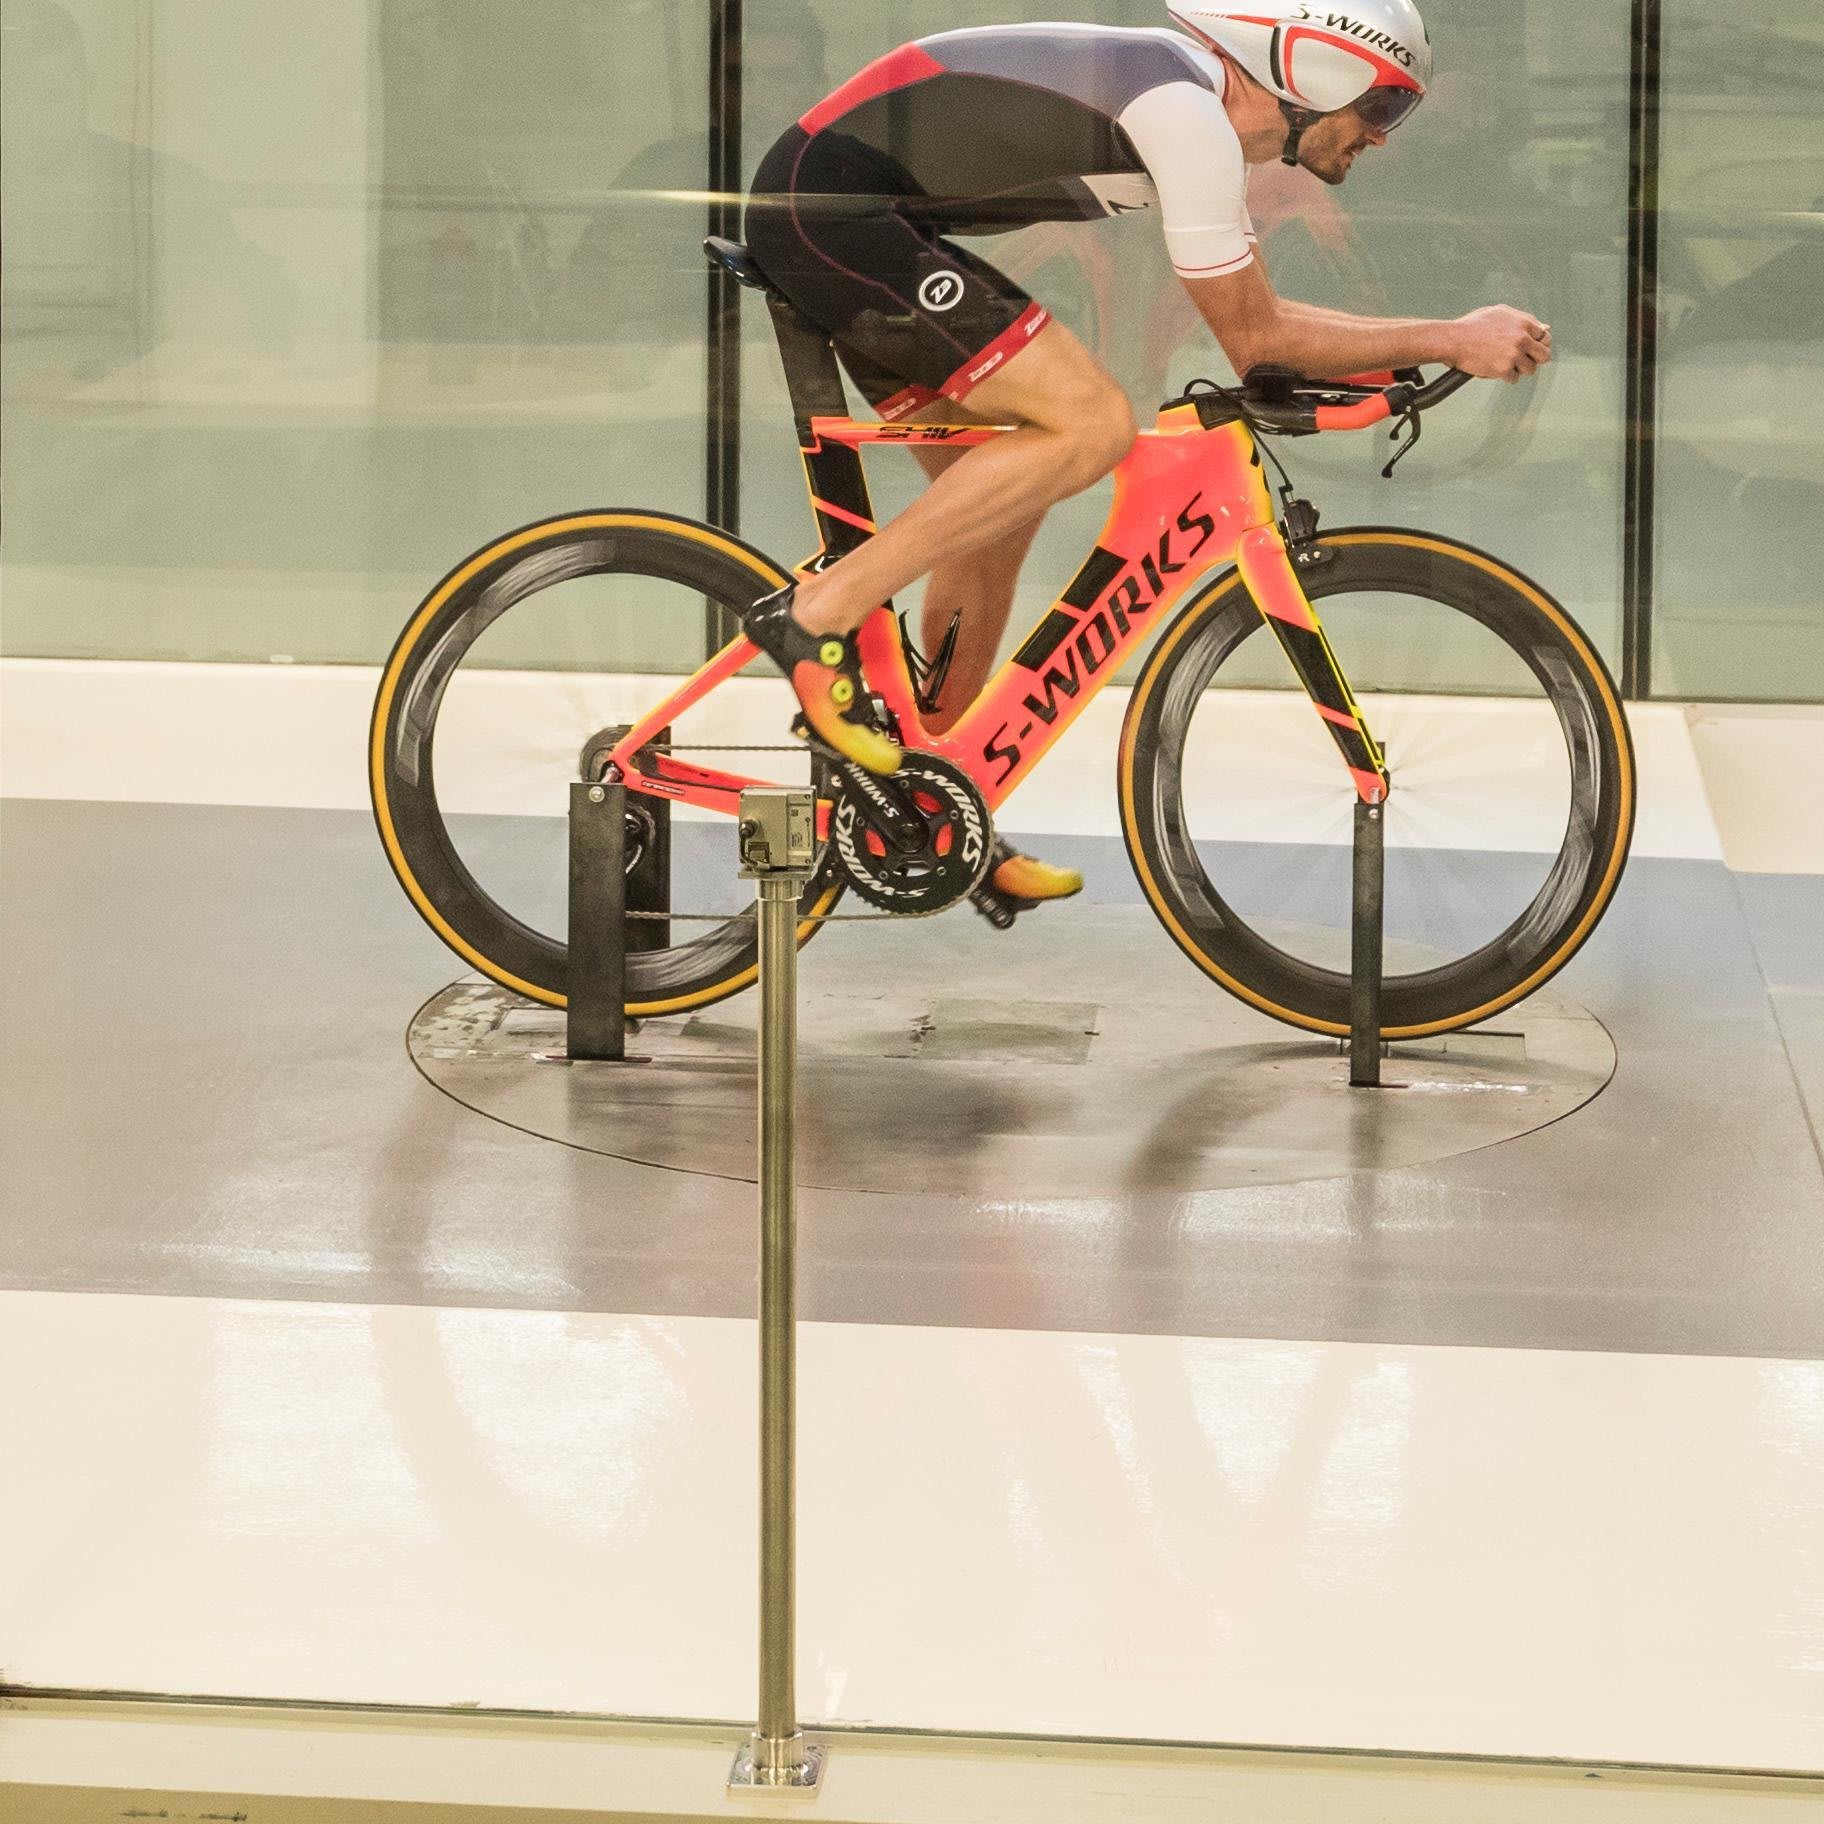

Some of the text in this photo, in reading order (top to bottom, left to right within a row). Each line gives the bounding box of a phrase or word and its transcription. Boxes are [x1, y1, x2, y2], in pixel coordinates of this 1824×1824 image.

[1289, 3, 1417, 68] S-WORKS
[982, 490, 1216, 788] S-WORKS
[843, 761, 900, 819] S-WORK
